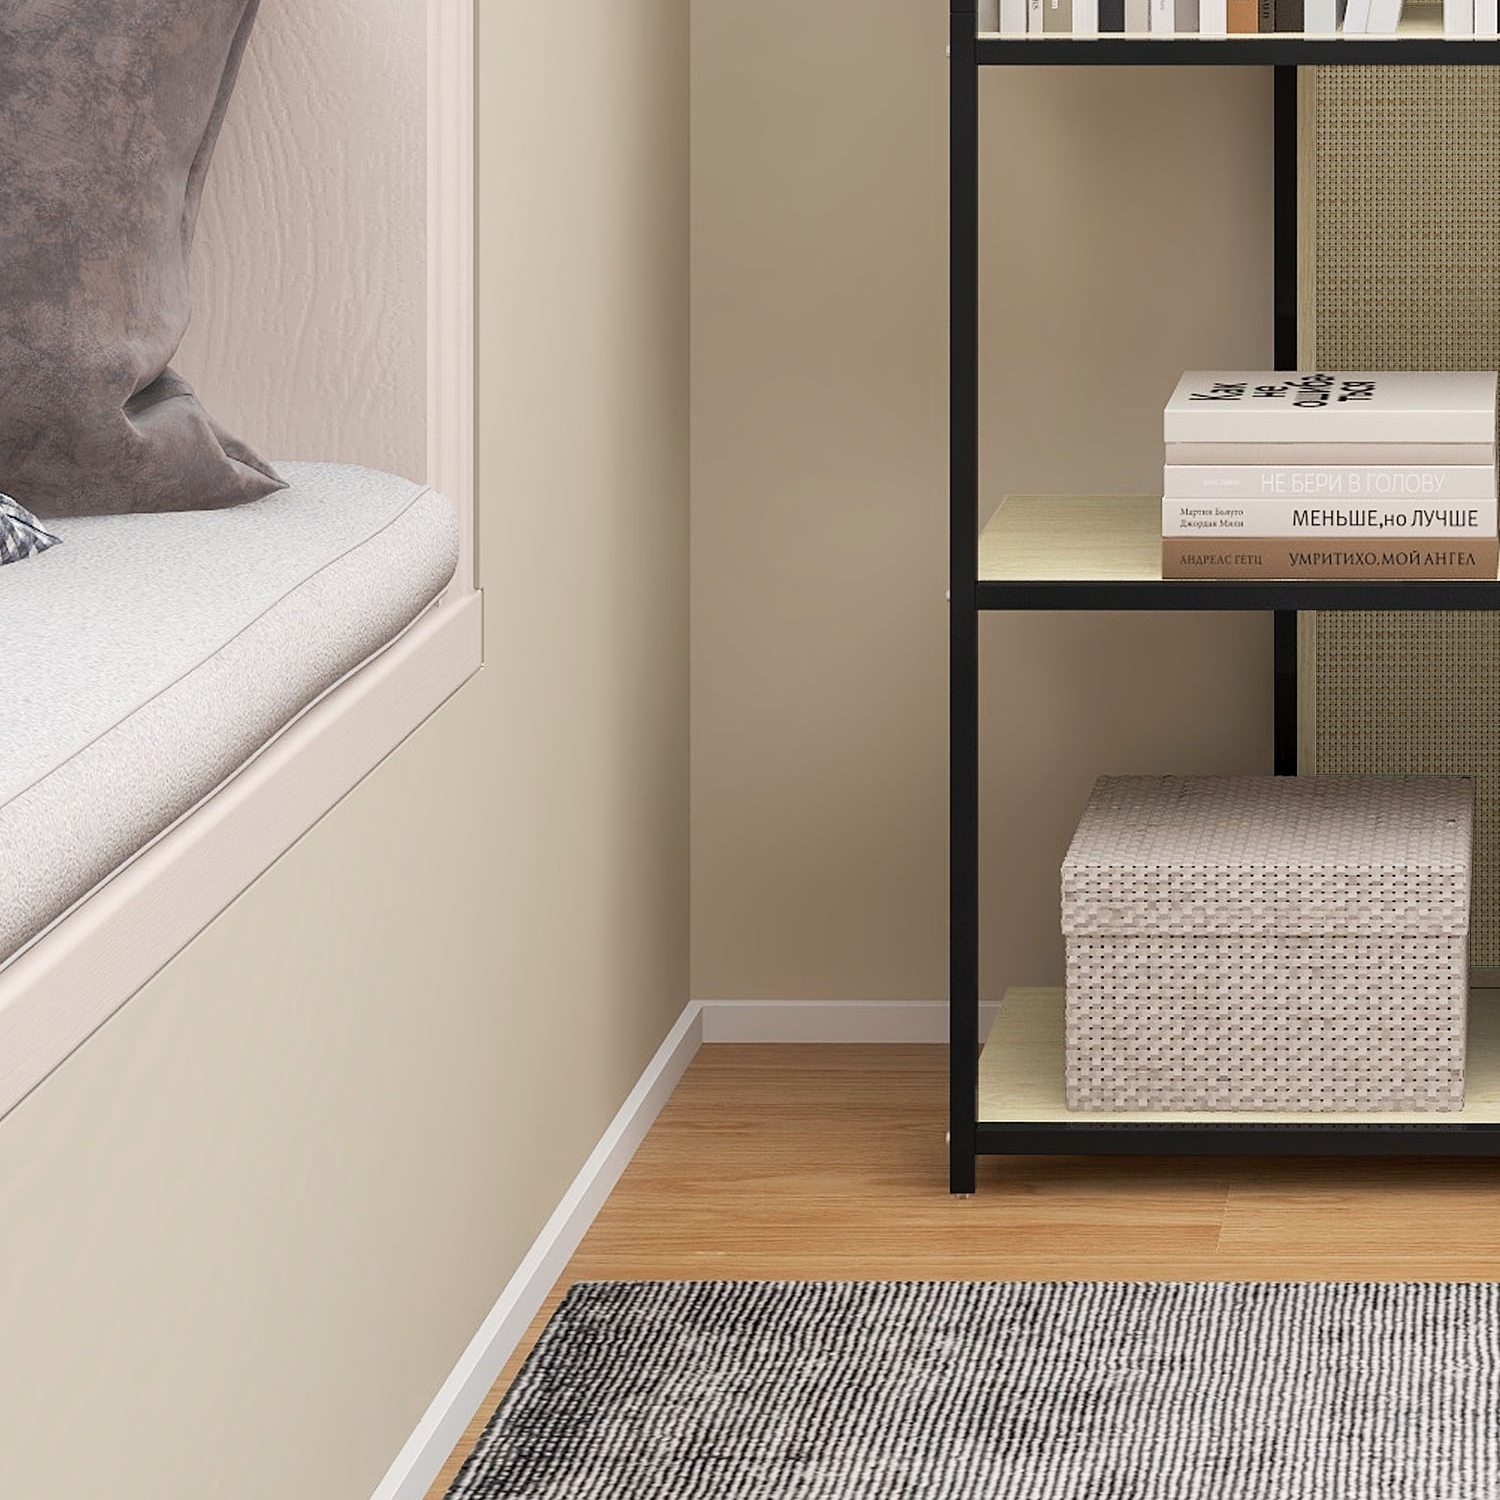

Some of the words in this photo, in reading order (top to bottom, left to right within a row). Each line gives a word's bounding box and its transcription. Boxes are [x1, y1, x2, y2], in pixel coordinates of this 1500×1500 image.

[1261, 473, 1285, 493] НЕ
[1291, 473, 1342, 493] БЕРИ
[1349, 473, 1361, 493] В
[1366, 473, 1446, 493] ГОЛОВУ
[1411, 510, 1479, 528] ЛУЧШЕ
[1424, 552, 1476, 566] АНГЕЛ
